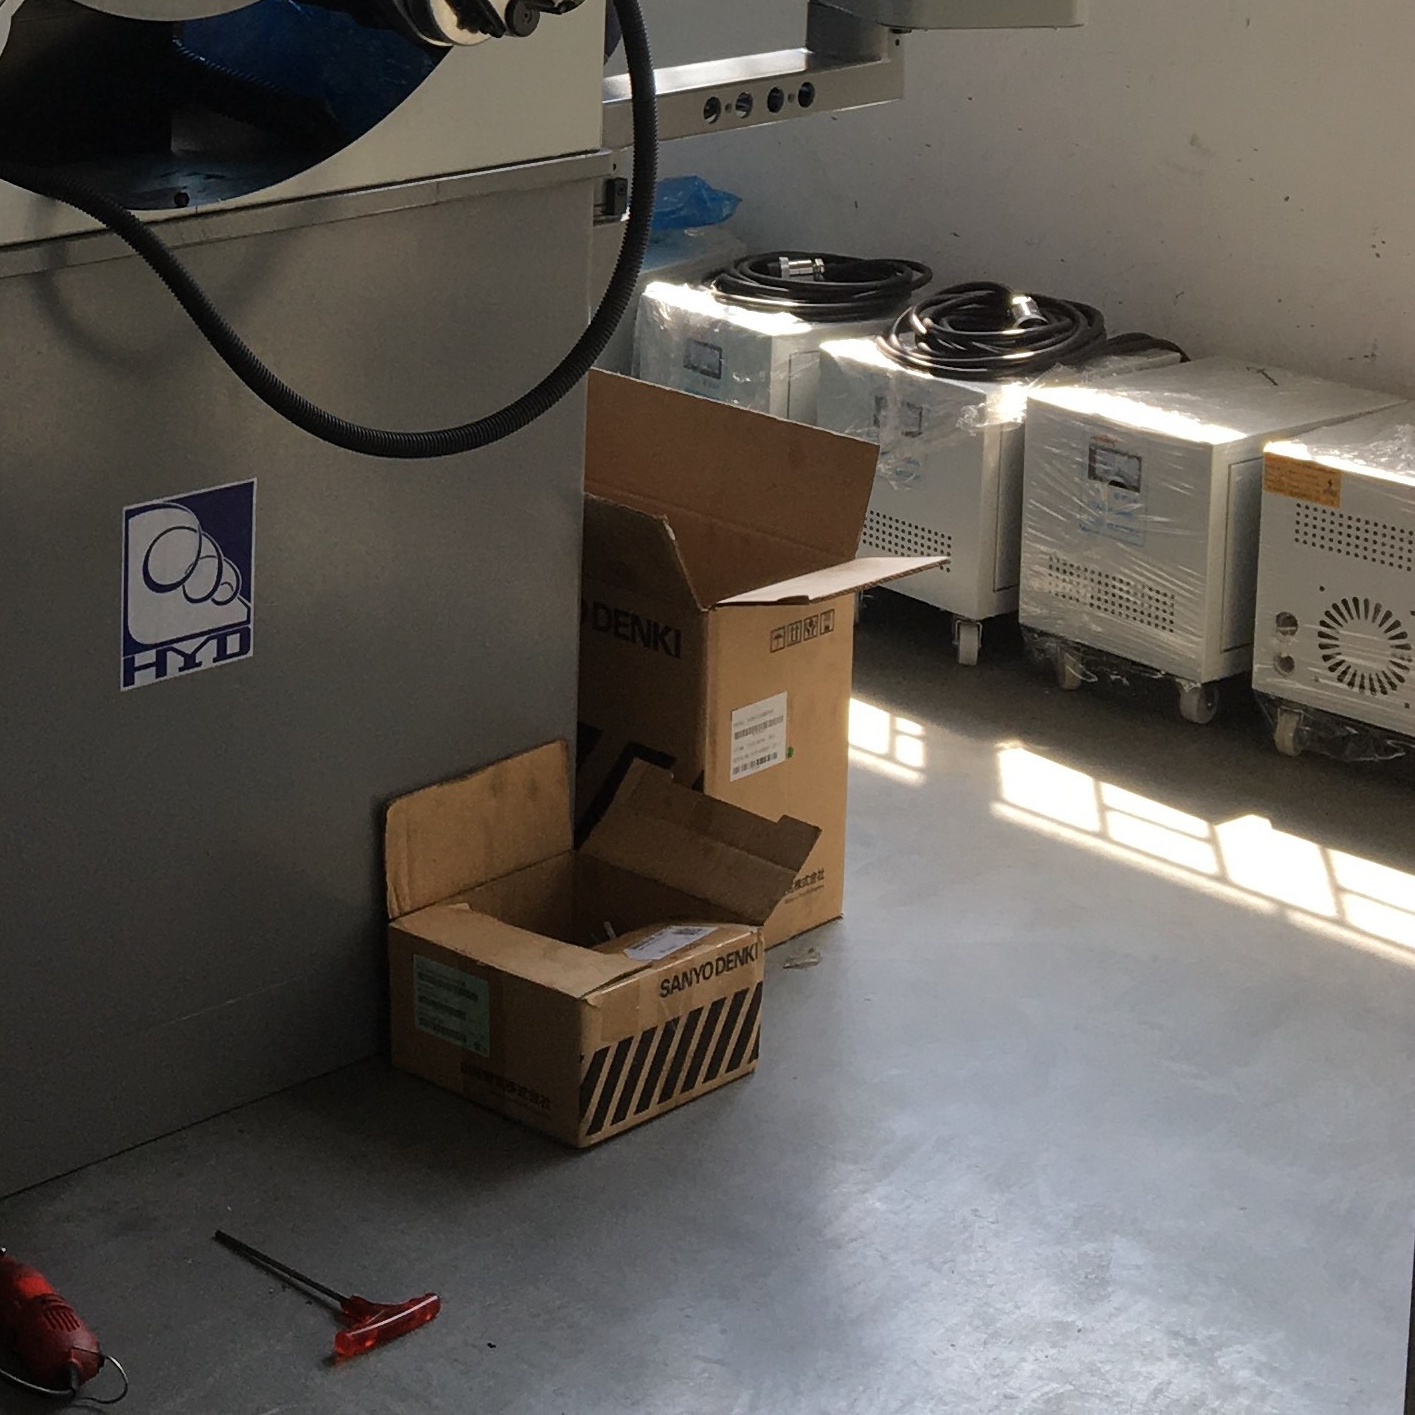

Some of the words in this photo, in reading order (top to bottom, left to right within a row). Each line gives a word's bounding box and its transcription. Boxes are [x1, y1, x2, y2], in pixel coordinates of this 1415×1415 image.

[122, 626, 251, 688] HYD
[592, 599, 681, 659] DENKI
[659, 960, 714, 998] SANYO
[715, 942, 759, 977] DENKI
